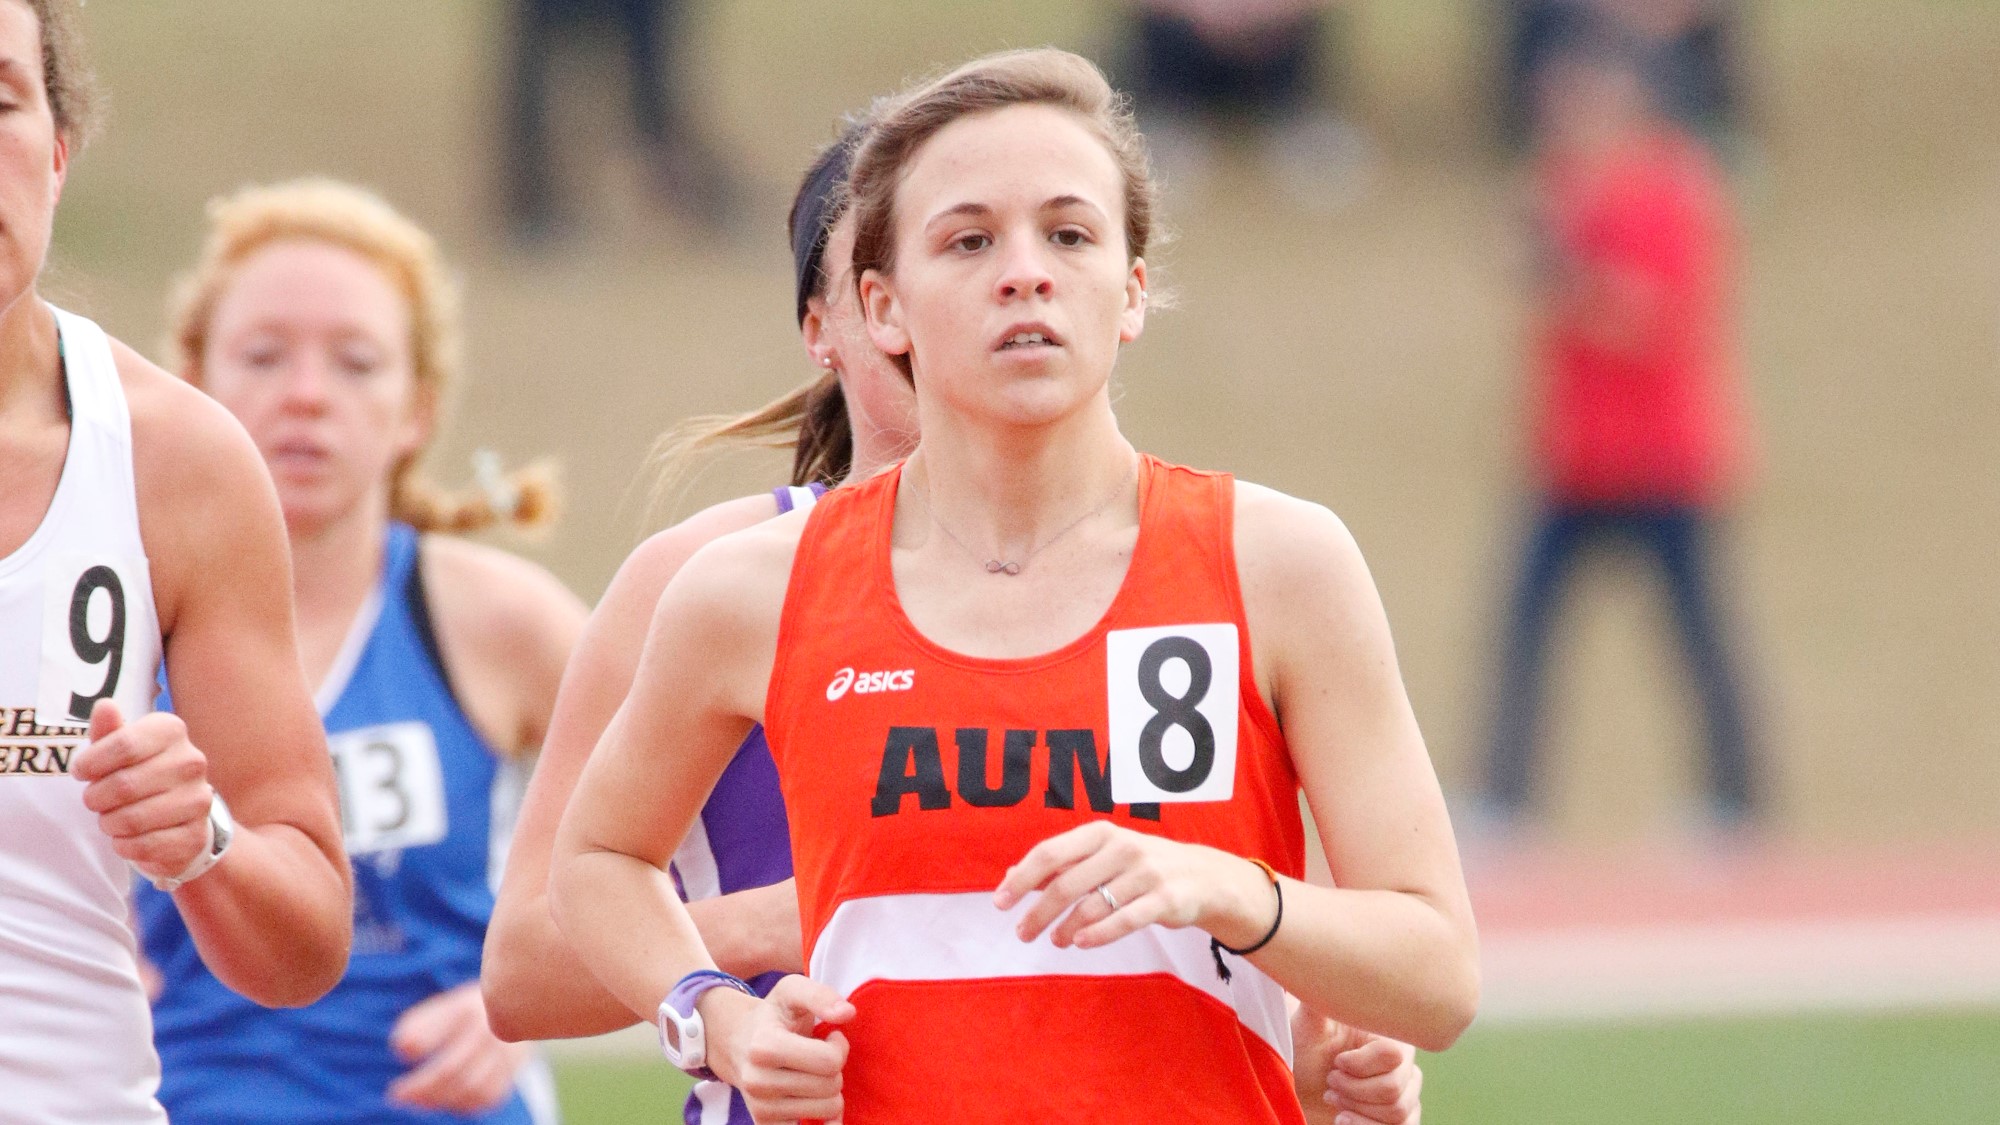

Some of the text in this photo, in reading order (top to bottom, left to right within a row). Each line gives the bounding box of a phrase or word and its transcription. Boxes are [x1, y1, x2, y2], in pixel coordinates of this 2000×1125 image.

[69, 565, 126, 720] 9
[853, 669, 915, 694] asics
[871, 726, 1160, 821] AUM
[1138, 636, 1215, 793] 8
